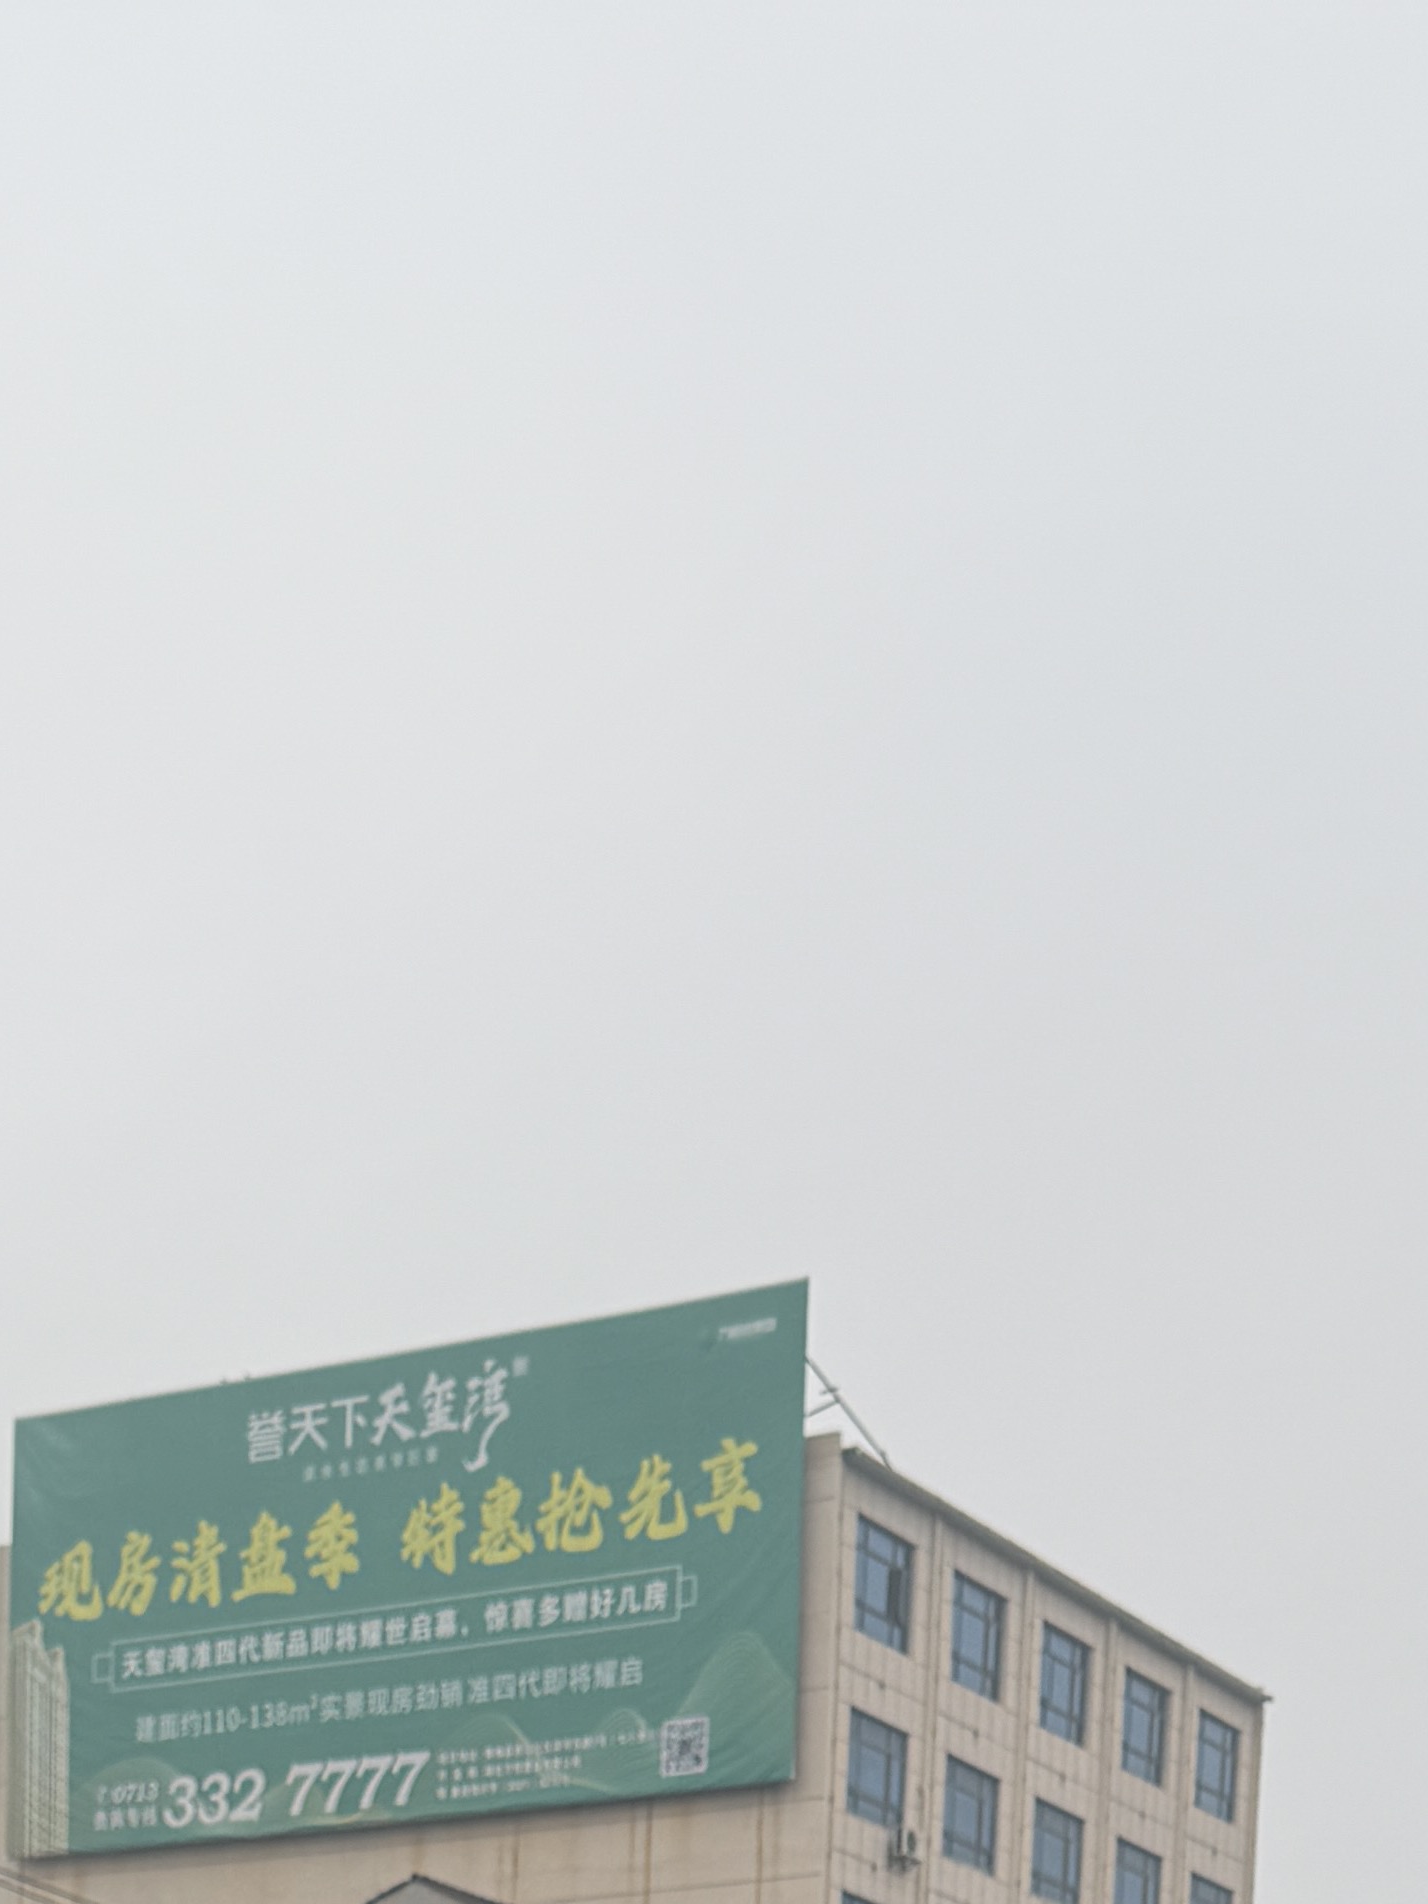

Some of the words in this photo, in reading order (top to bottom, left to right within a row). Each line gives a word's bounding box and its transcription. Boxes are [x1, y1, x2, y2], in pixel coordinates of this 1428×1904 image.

[37, 1501, 360, 1621] 现房清盘季
[400, 1437, 761, 1576] 特惠抢先享
[162, 1767, 268, 1829] 332
[285, 1749, 431, 1817] 7777
